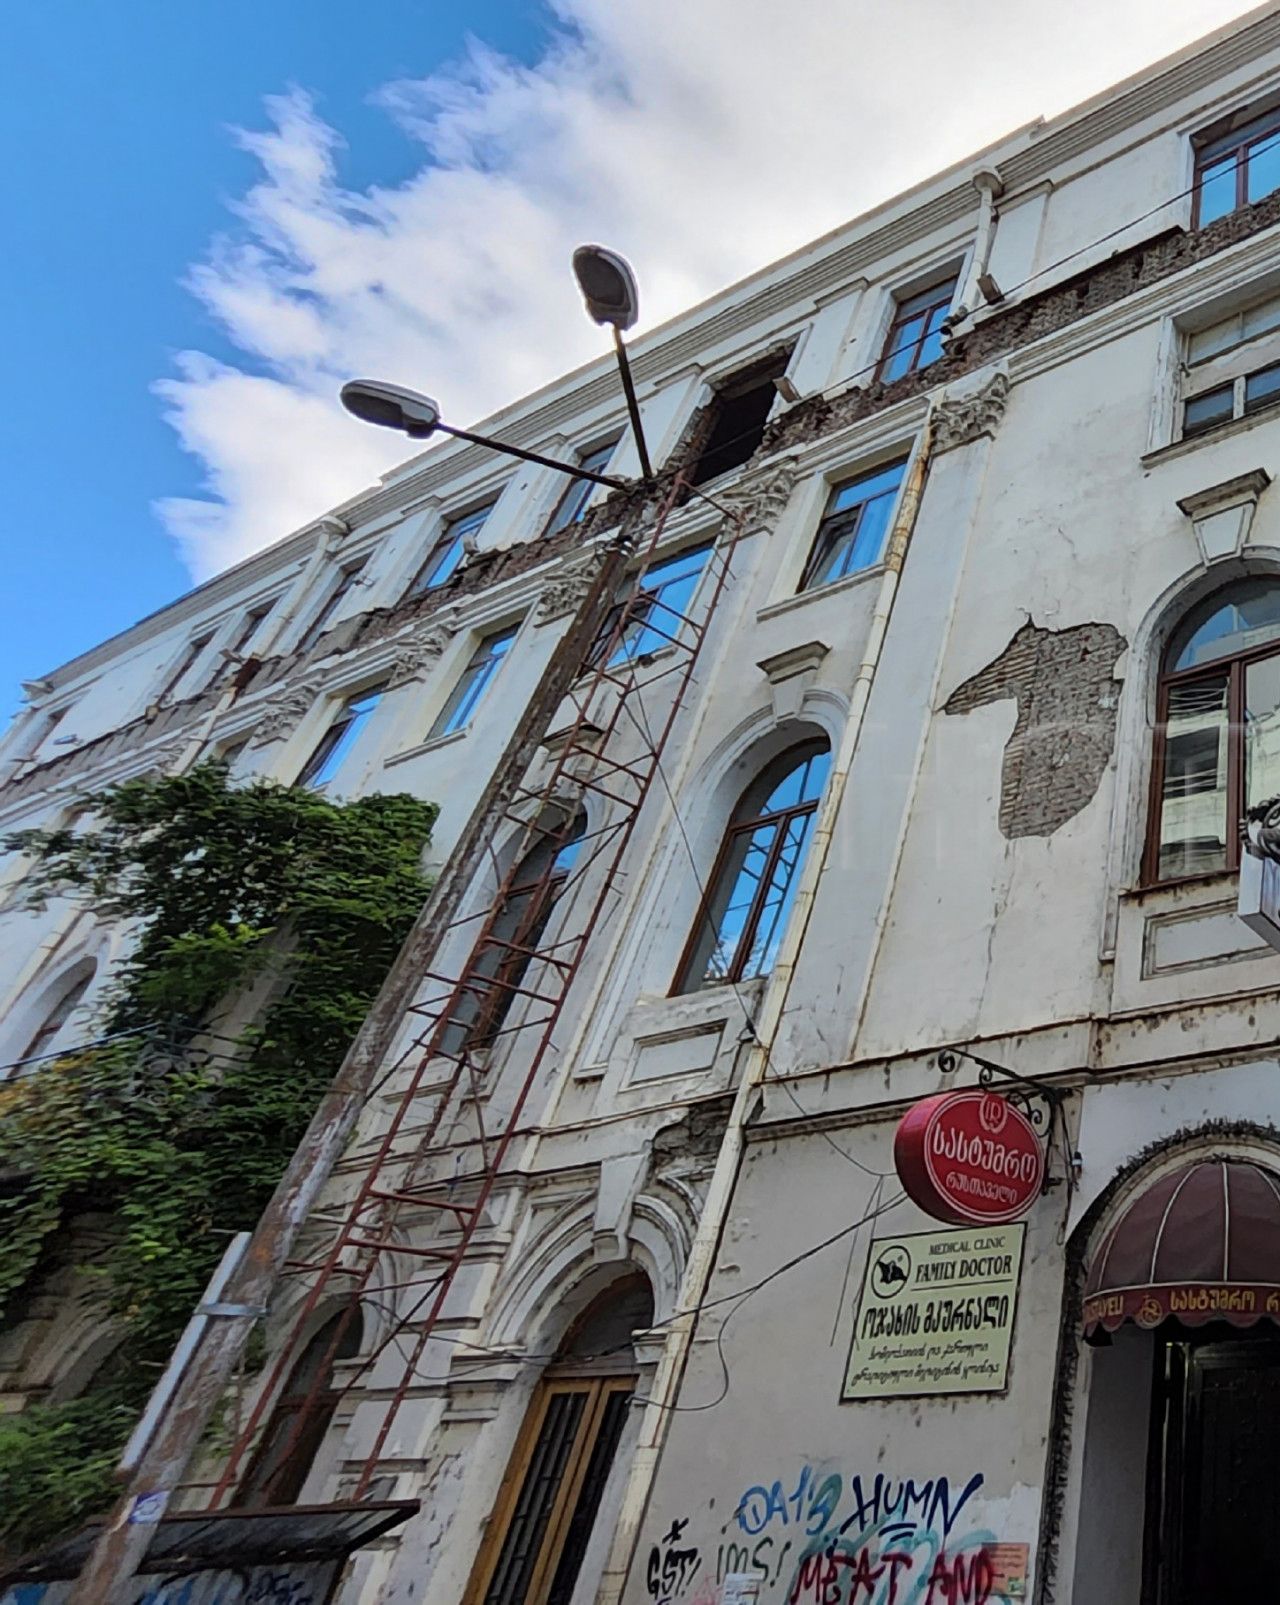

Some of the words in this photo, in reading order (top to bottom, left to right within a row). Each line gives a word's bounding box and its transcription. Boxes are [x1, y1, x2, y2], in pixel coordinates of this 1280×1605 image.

[932, 1122, 1037, 1184] სასტუმრო
[945, 1171, 1018, 1205] რუსთაველი
[929, 1242, 971, 1256] MEDICAL
[973, 1236, 1006, 1250] CLINIC
[915, 1260, 958, 1283] FAMILY
[958, 1255, 1013, 1279] DOCTOR
[1169, 1289, 1256, 1312] სასტუმრო
[861, 1301, 921, 1340] ოჯახის
[923, 1295, 1010, 1334] მკურნალი
